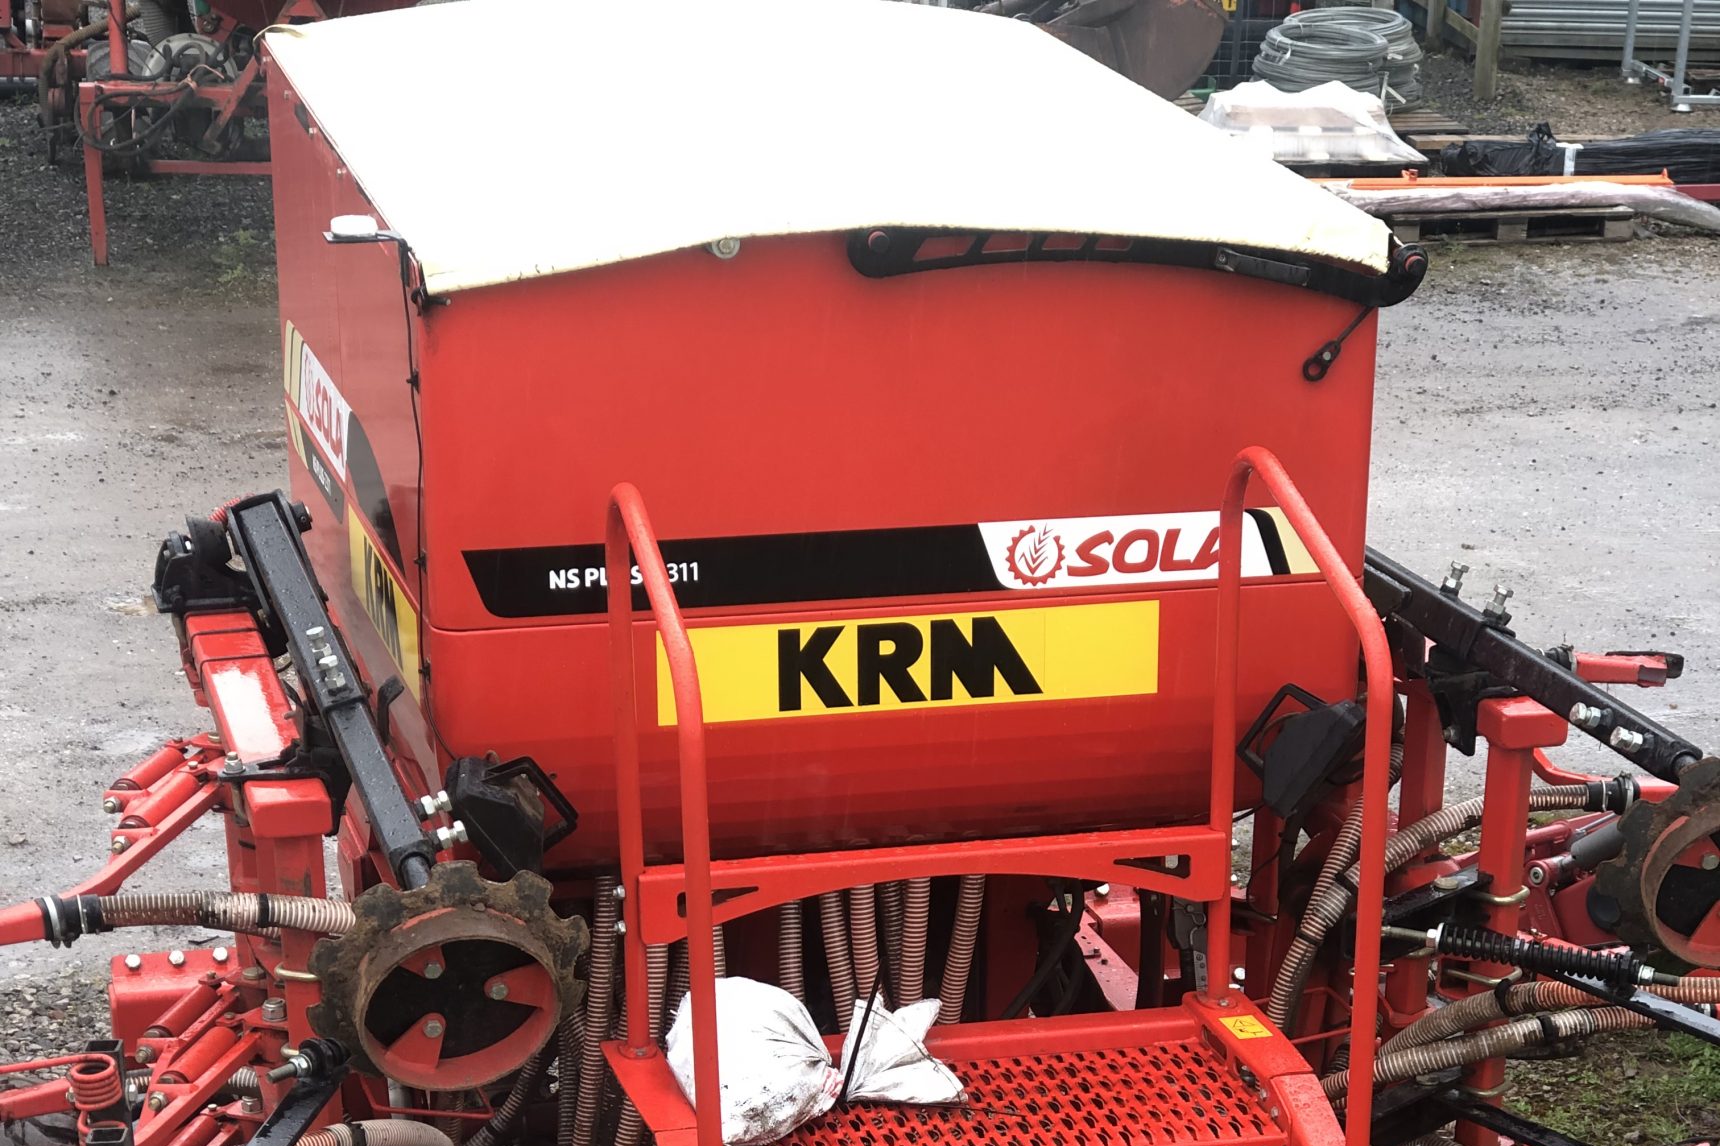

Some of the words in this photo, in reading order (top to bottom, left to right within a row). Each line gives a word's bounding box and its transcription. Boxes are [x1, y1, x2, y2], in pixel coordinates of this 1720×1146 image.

[314, 377, 345, 470] SOLA
[363, 534, 404, 673] KRM
[549, 568, 581, 589] NS
[584, 565, 645, 588] PLS
[778, 616, 1044, 712] KRM
